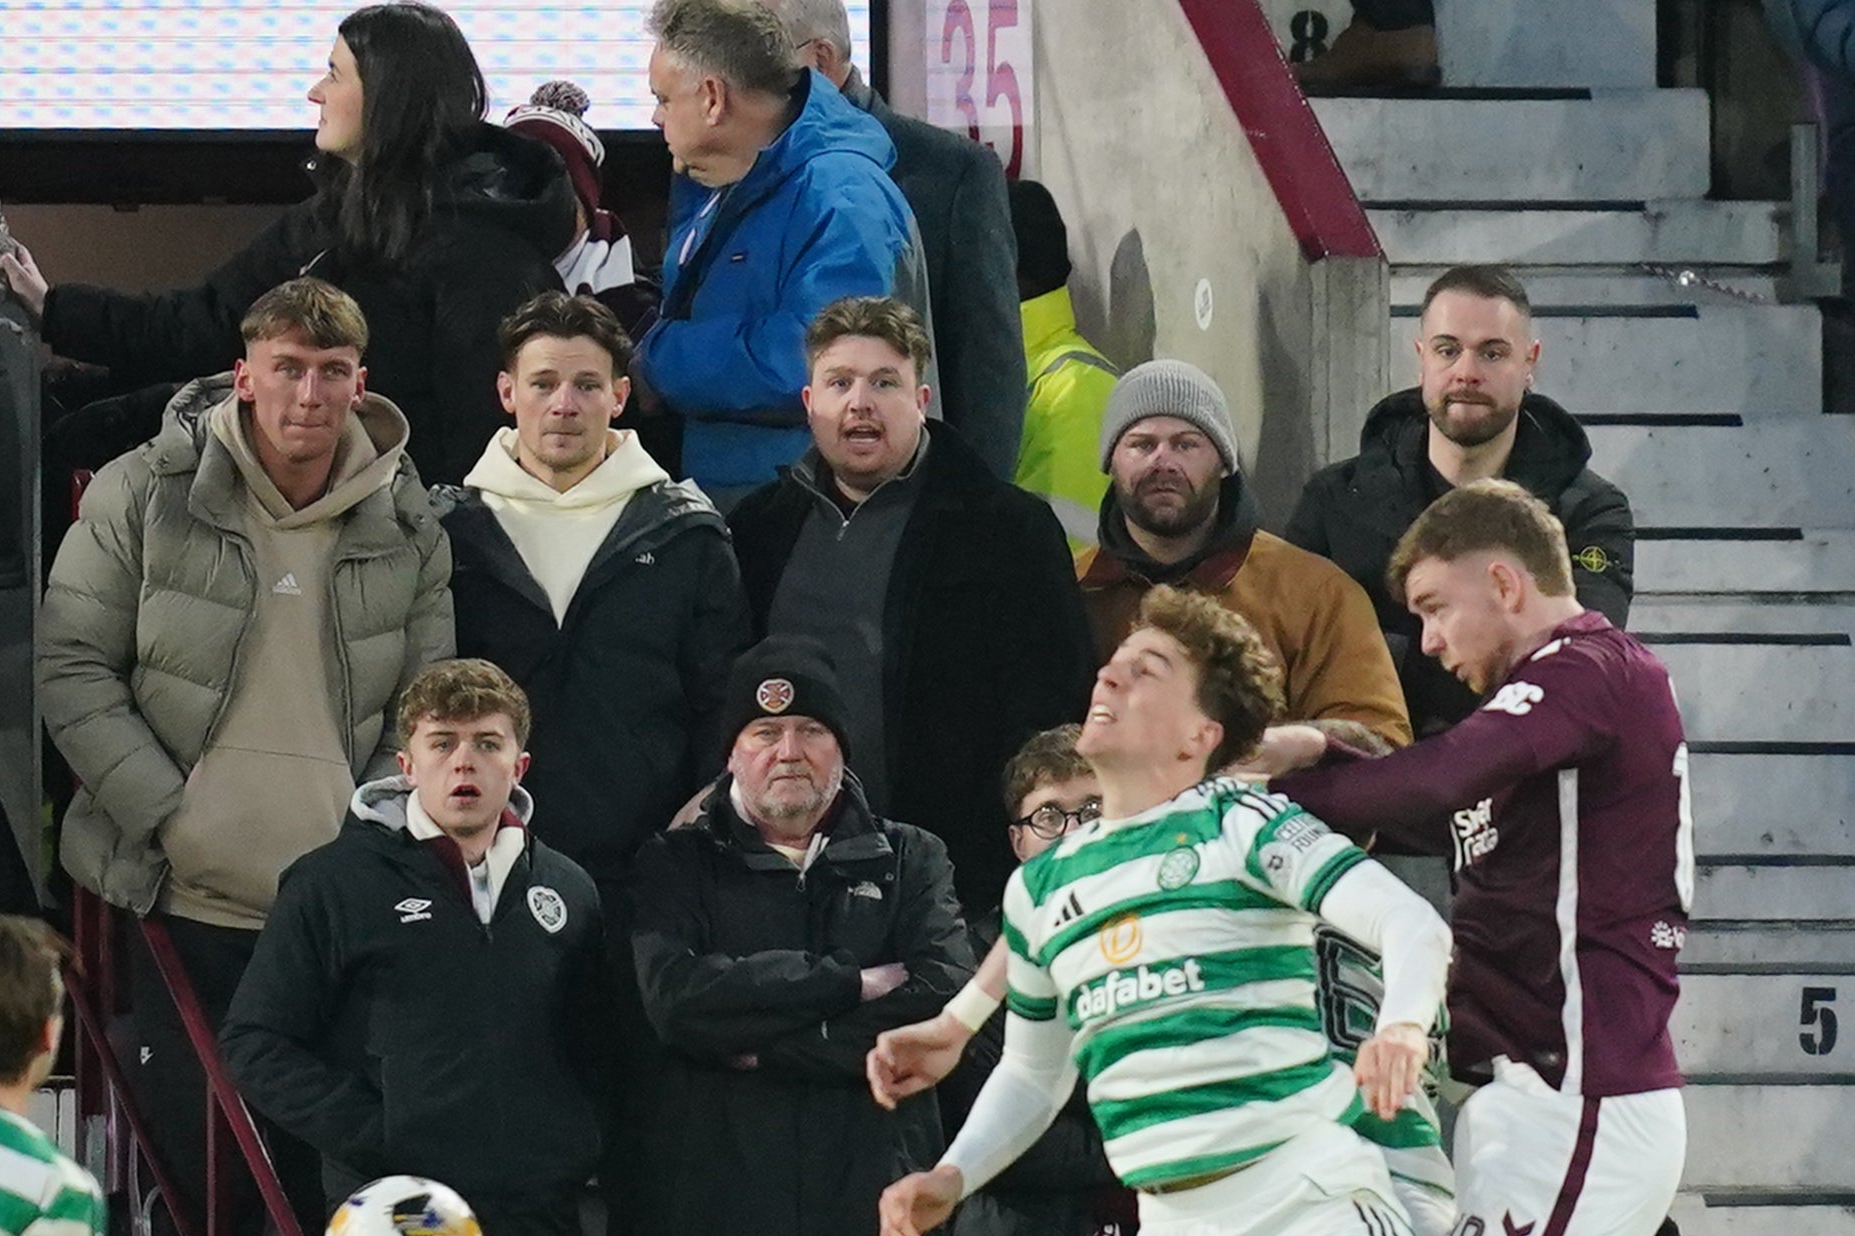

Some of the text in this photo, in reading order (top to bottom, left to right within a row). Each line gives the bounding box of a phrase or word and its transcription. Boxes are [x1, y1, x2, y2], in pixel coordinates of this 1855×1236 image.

[1290, 9, 1329, 65] 8
[942, 0, 1023, 180] 35
[1076, 958, 1205, 1021] dafabet
[1799, 986, 1838, 1056] 5
